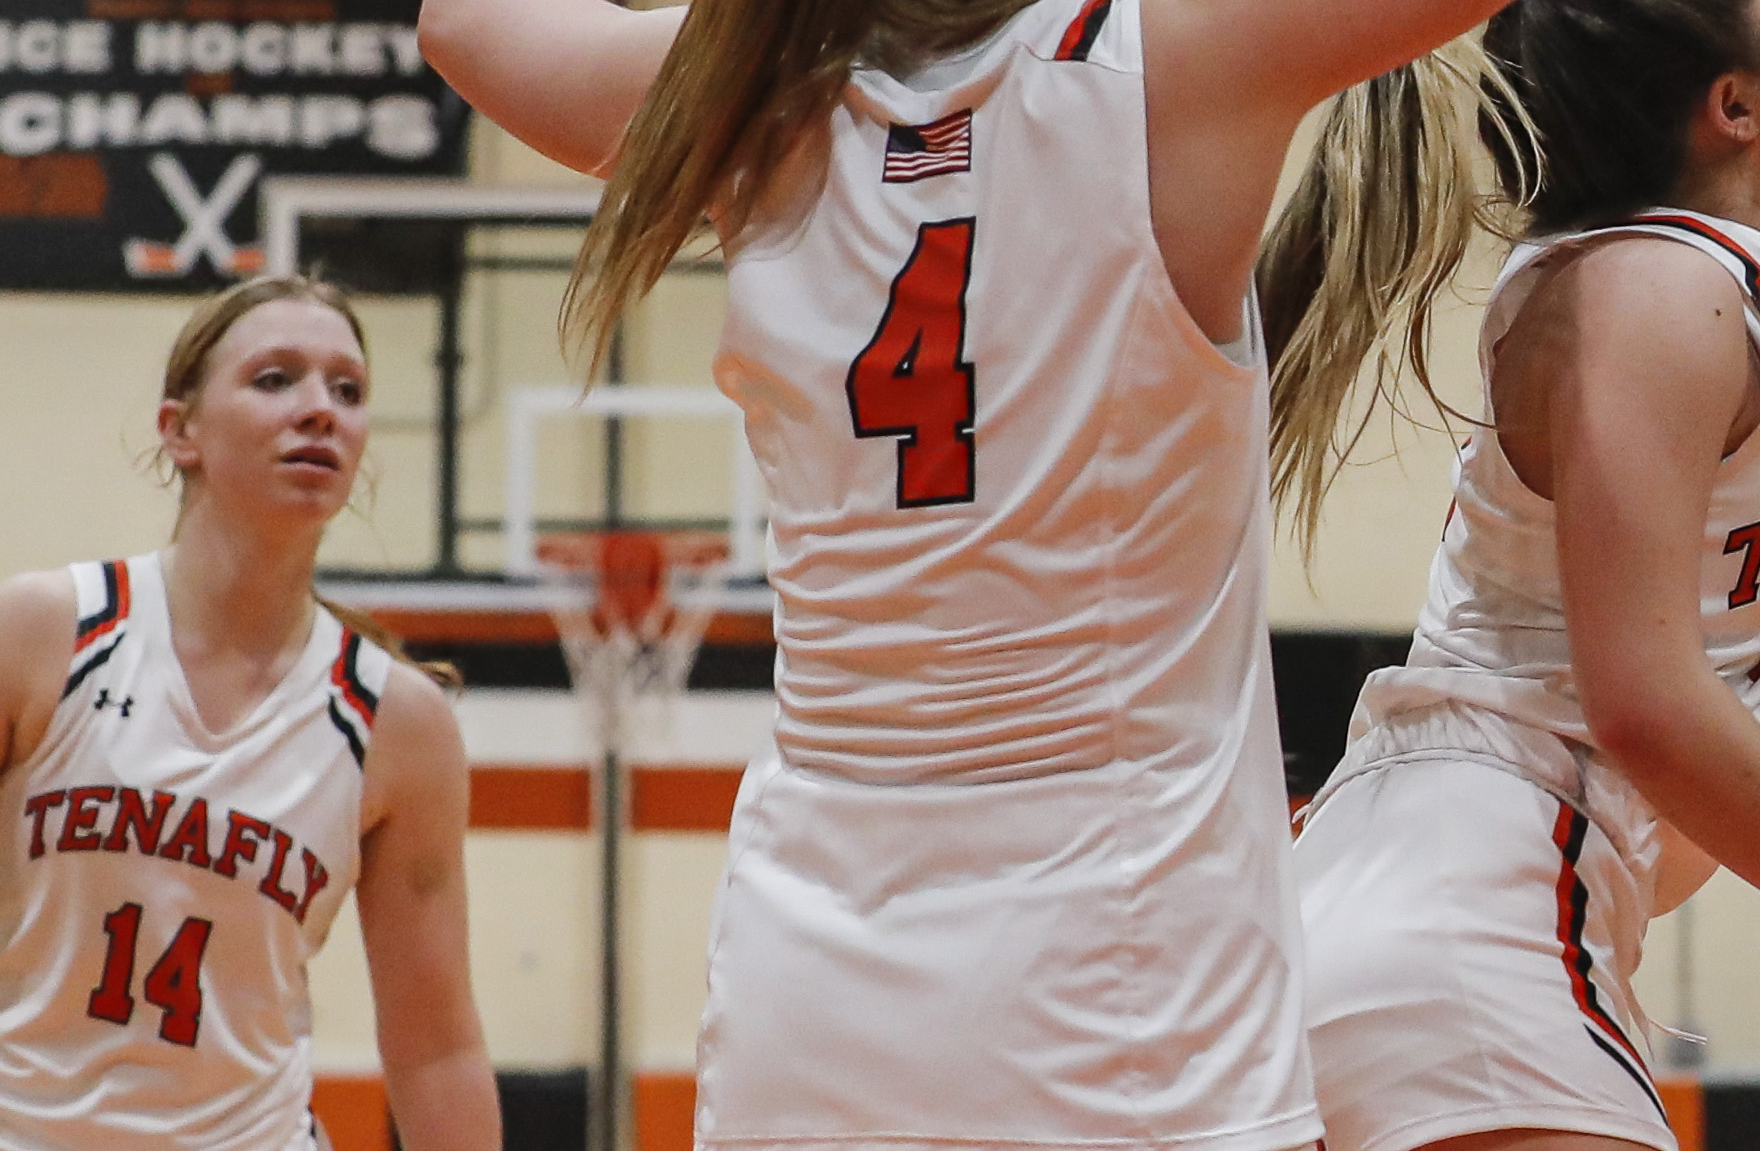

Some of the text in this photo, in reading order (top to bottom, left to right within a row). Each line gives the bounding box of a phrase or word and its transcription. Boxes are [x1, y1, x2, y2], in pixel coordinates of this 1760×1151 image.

[0, 91, 440, 159] CHAMPS
[845, 216, 976, 510] 4
[24, 786, 330, 925] TENAFLY
[87, 901, 214, 1049] 14
